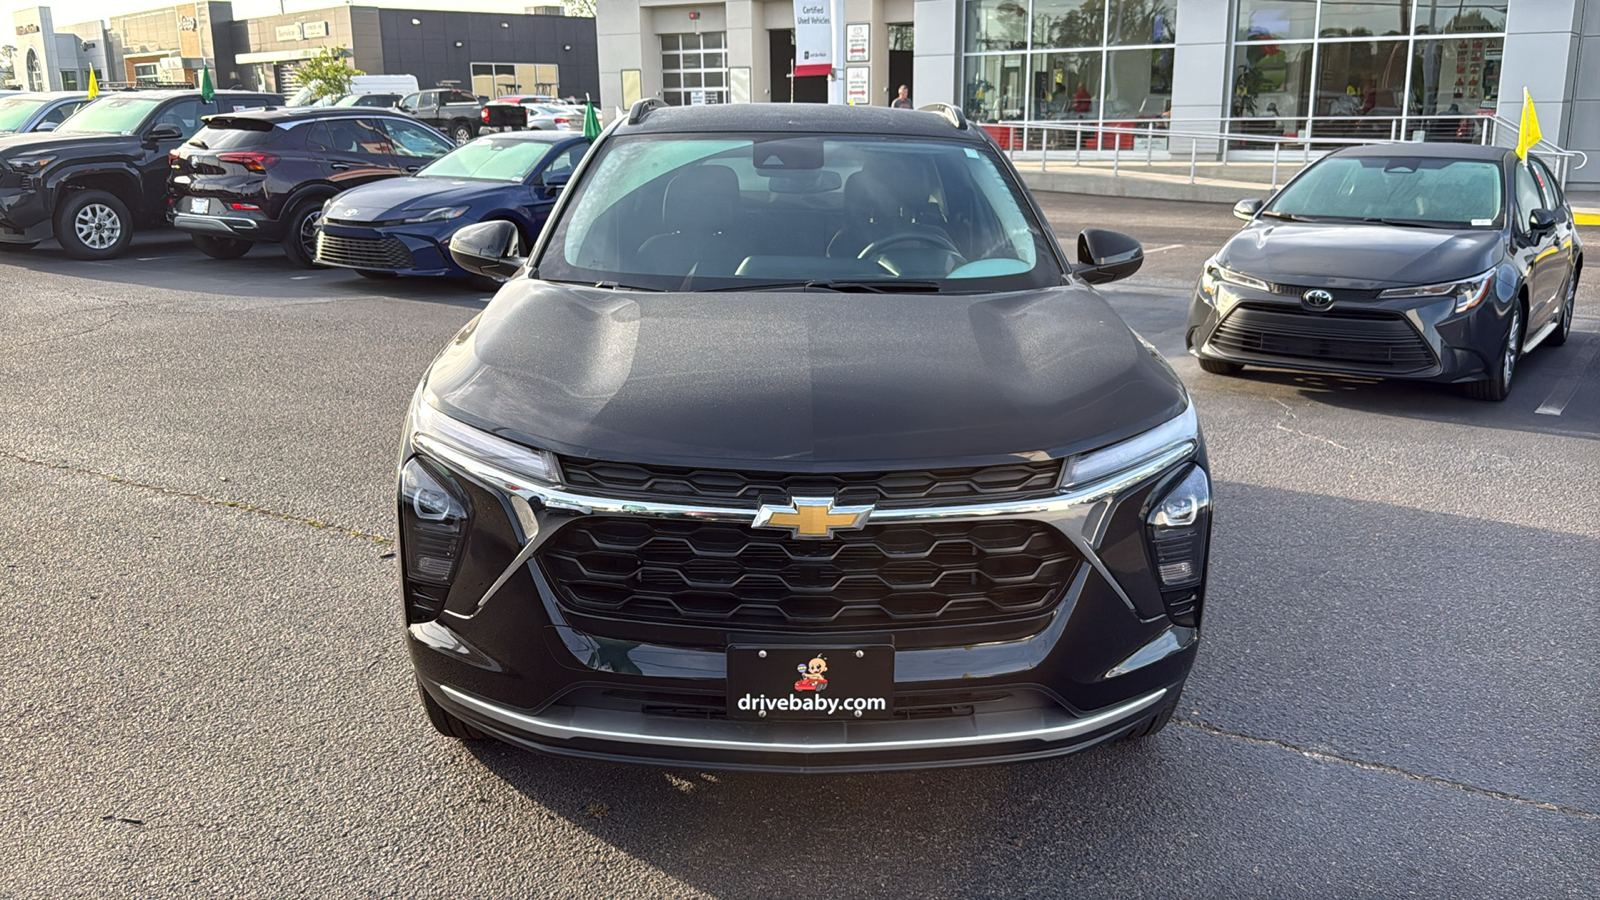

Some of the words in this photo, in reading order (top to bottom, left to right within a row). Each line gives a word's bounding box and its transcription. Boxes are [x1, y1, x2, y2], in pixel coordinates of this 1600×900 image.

[802, 6, 824, 14] Certified
[797, 17, 810, 25] Used
[811, 16, 830, 25] Vehicles
[737, 693, 886, 715] drivebaby.com
